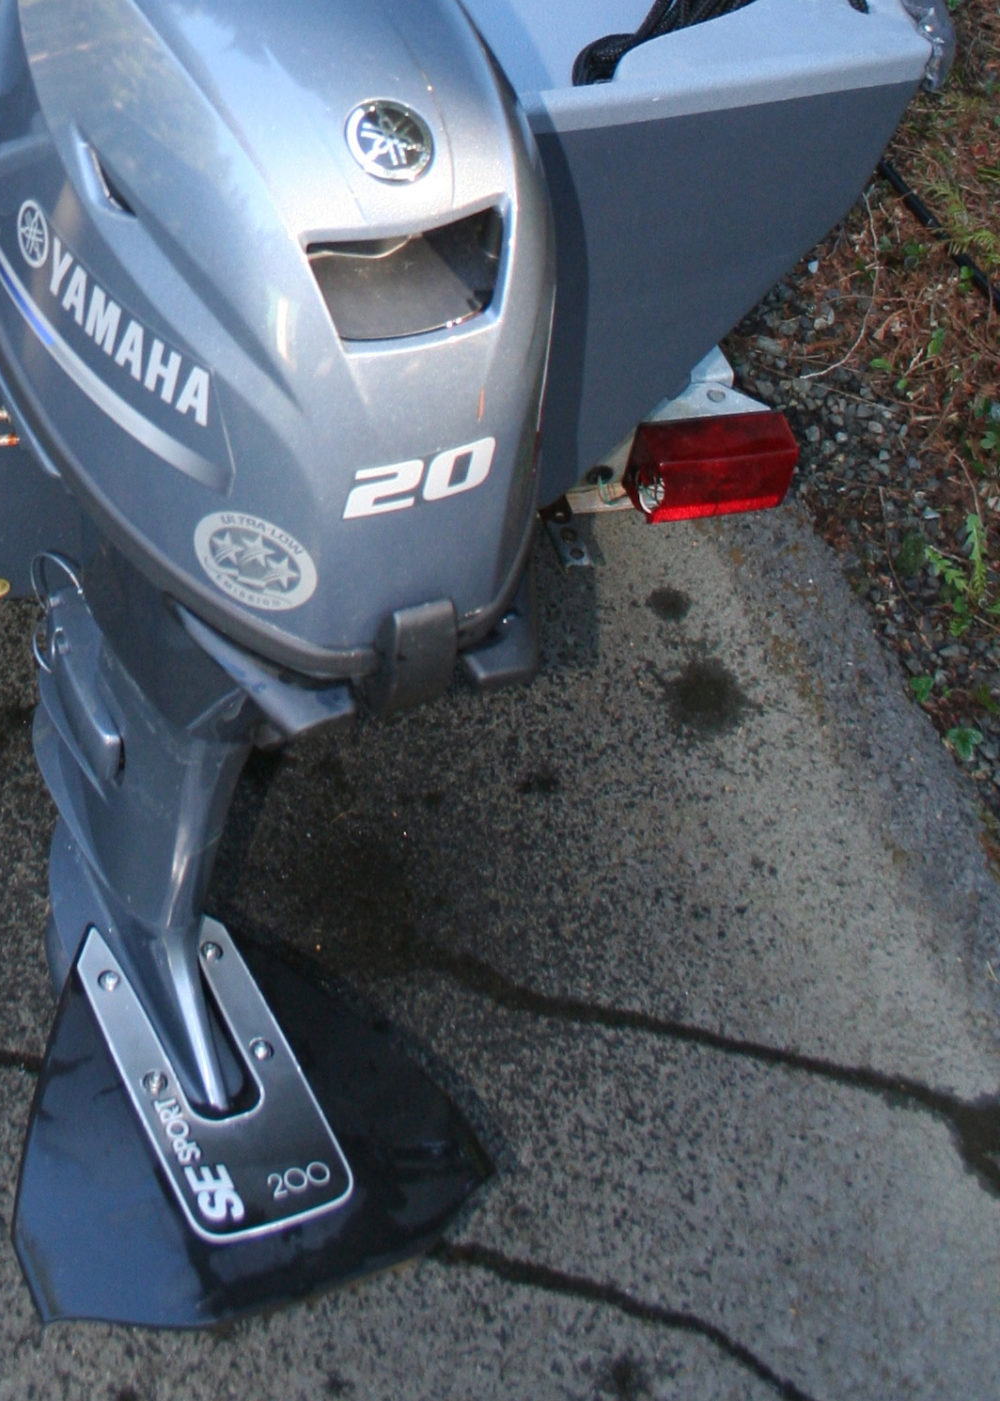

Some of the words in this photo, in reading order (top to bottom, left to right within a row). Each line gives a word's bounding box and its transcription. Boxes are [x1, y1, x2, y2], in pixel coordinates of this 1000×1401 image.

[49, 236, 209, 427] YAMAHA
[343, 436, 496, 519] 20
[220, 514, 266, 532] ULTRA
[270, 527, 303, 555] LOW
[153, 1098, 201, 1164] SPORT
[184, 1164, 244, 1221] SE
[267, 1161, 331, 1199] 200
